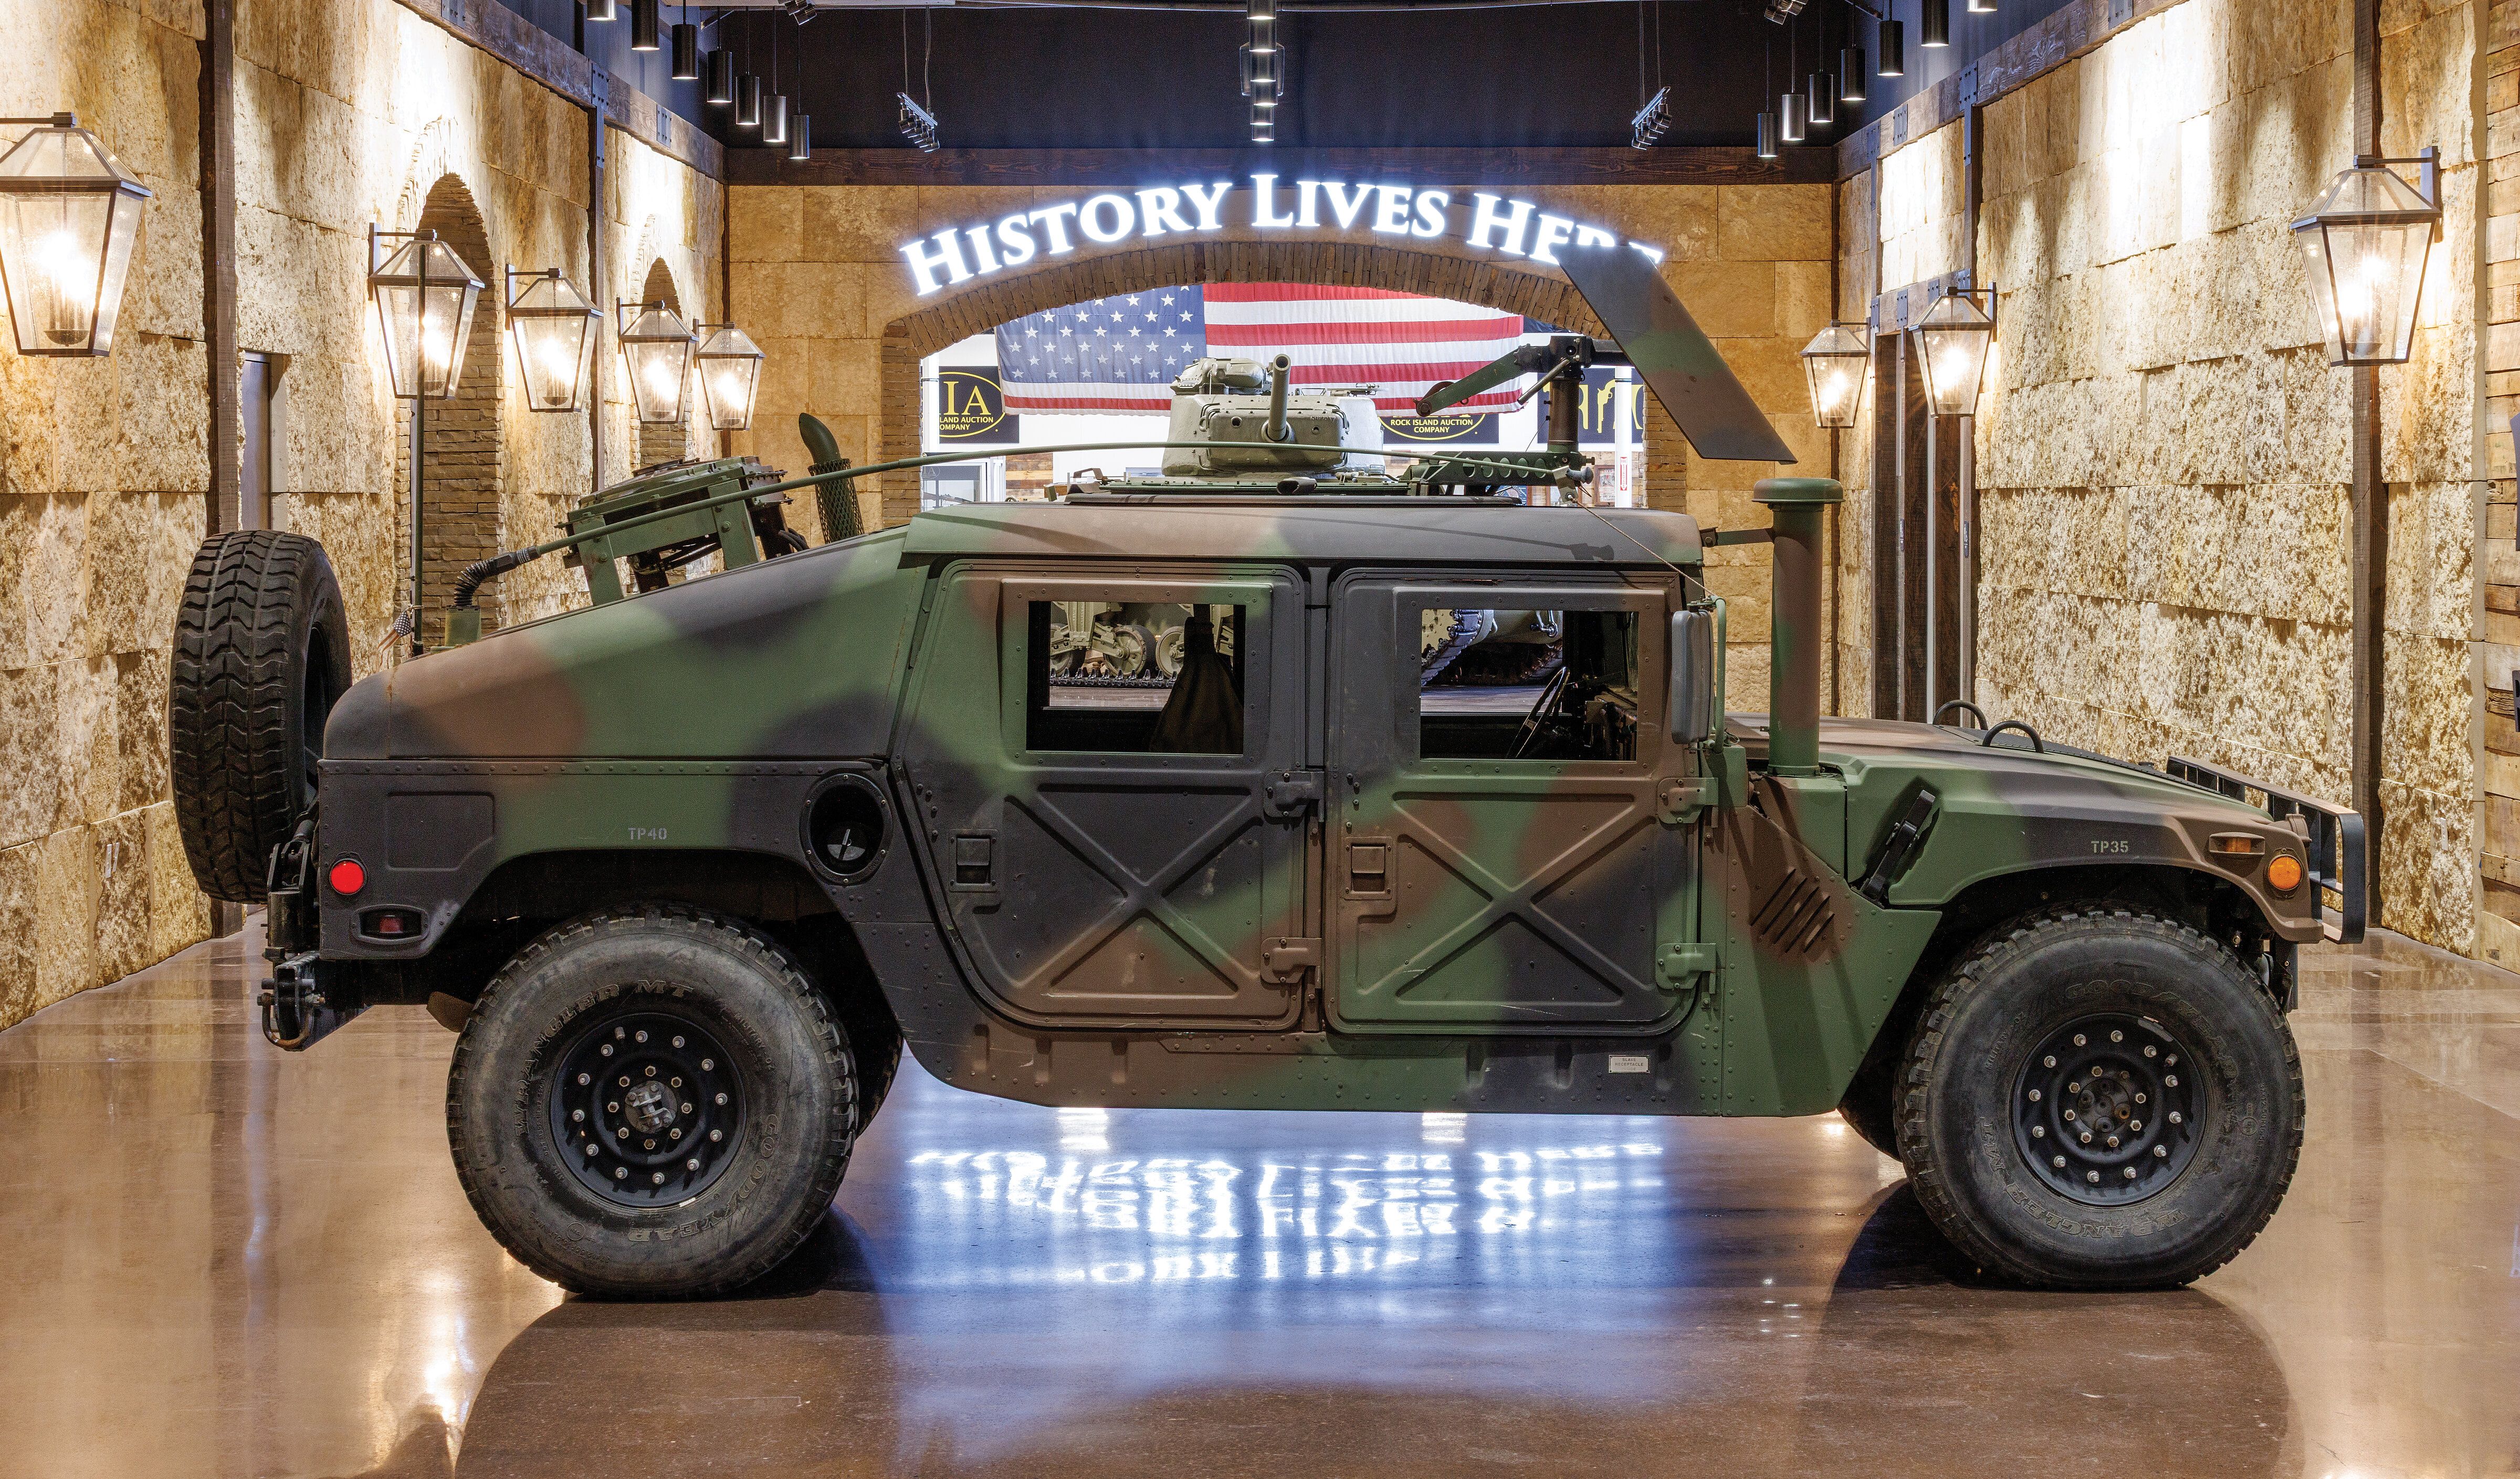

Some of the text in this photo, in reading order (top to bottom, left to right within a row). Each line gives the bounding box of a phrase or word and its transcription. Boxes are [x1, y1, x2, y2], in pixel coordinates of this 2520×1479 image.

[899, 174, 1664, 297] HISTORY LIVES HE
[940, 381, 992, 415] IA
[628, 827, 667, 840] TP40
[2091, 840, 2129, 853] TP35
[636, 979, 694, 998] MT
[628, 1114, 780, 1242] GOODYEAR
